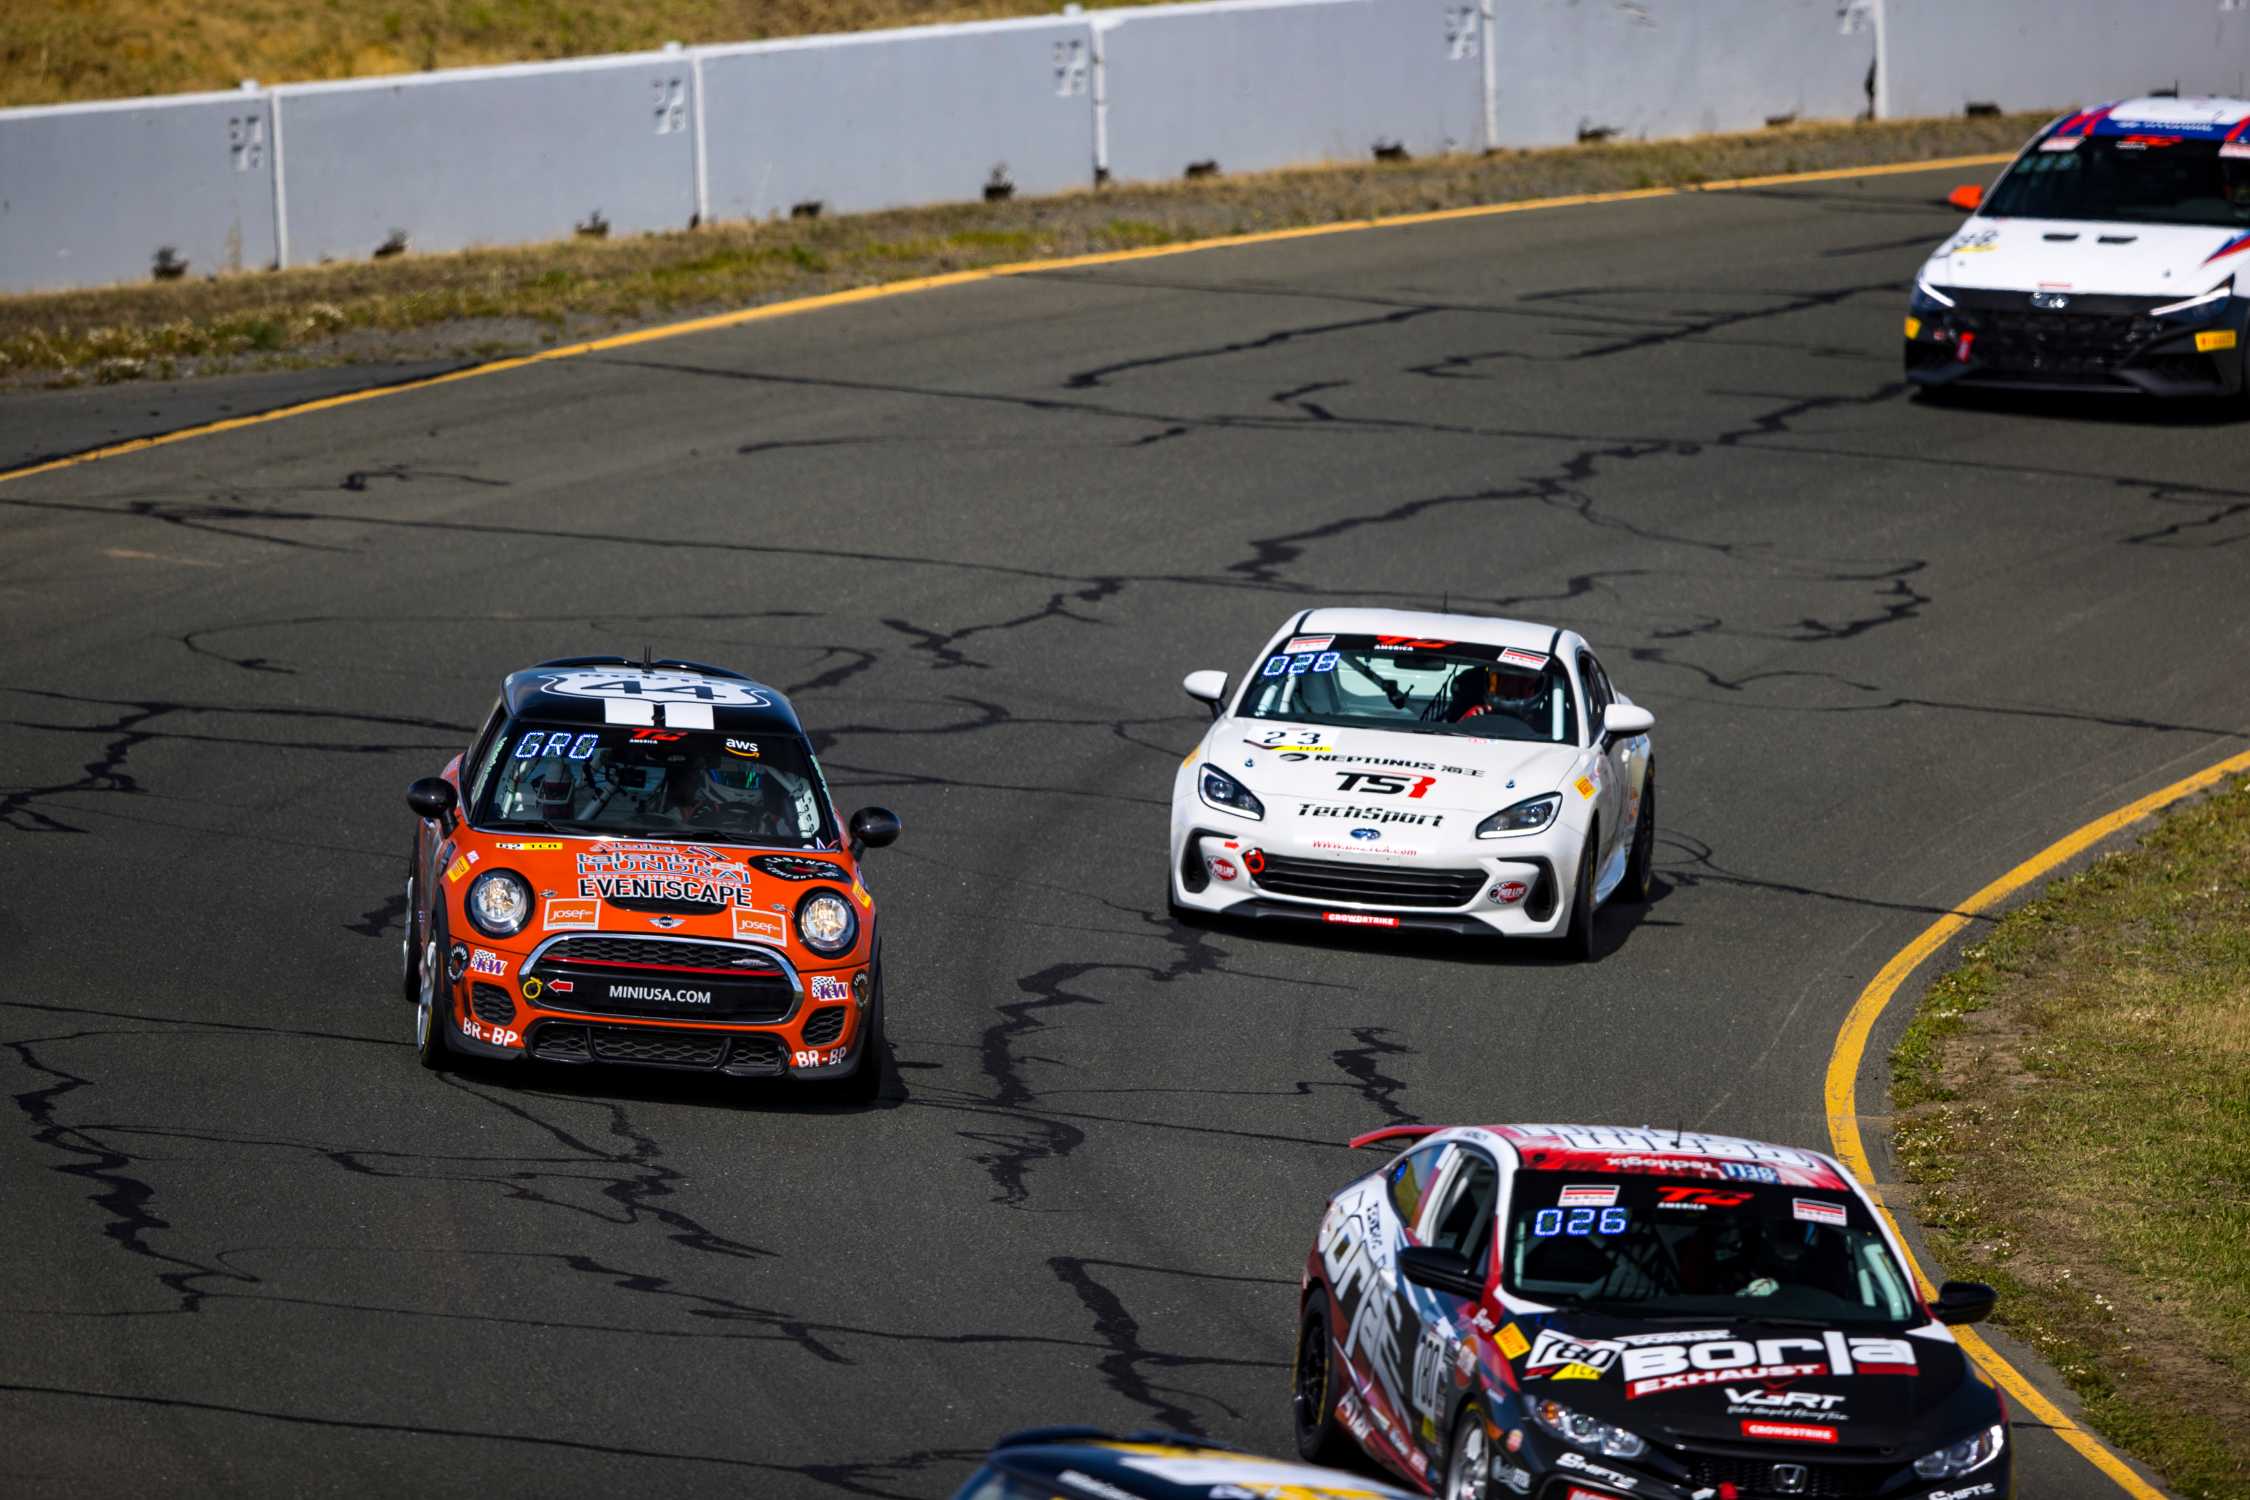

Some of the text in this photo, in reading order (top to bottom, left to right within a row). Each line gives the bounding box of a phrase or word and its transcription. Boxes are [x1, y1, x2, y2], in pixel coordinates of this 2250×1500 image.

[580, 680, 727, 700] 44
[725, 738, 759, 752] aws
[1315, 754, 1435, 770] NEPTUNUS
[1299, 803, 1445, 827] TechSport
[579, 878, 752, 907] EVENTSCAPE
[609, 985, 711, 1004] MINIUSA.COM
[1606, 1155, 1722, 1174] Techlogix
[1534, 1207, 1627, 1236] 026
[1634, 1363, 1821, 1392] EXHAUST
